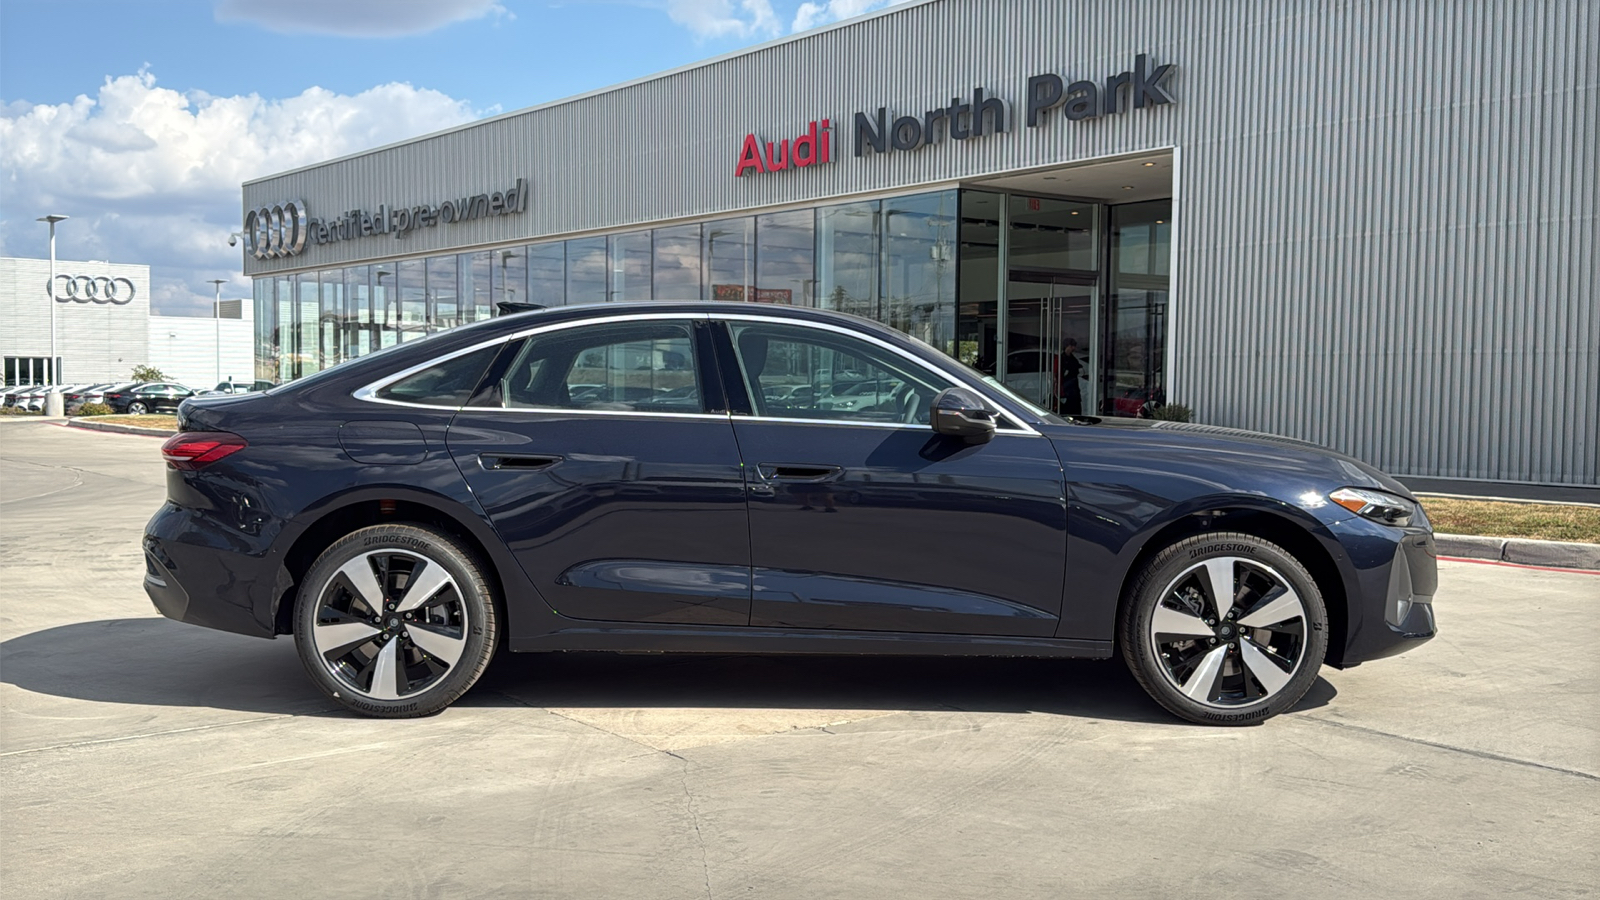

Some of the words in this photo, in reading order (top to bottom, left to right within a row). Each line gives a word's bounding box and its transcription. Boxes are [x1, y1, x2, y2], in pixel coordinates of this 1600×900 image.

[735, 118, 835, 177] Audi
[854, 86, 1012, 158] North
[1027, 53, 1178, 128] Park
[307, 204, 390, 246] Certified
[364, 535, 431, 550] BRIDGESTONE
[1189, 543, 1257, 559] BRIDGESTONE
[352, 698, 418, 713] BRIDGESTONE
[1202, 707, 1270, 722] BRIDGESTONE
